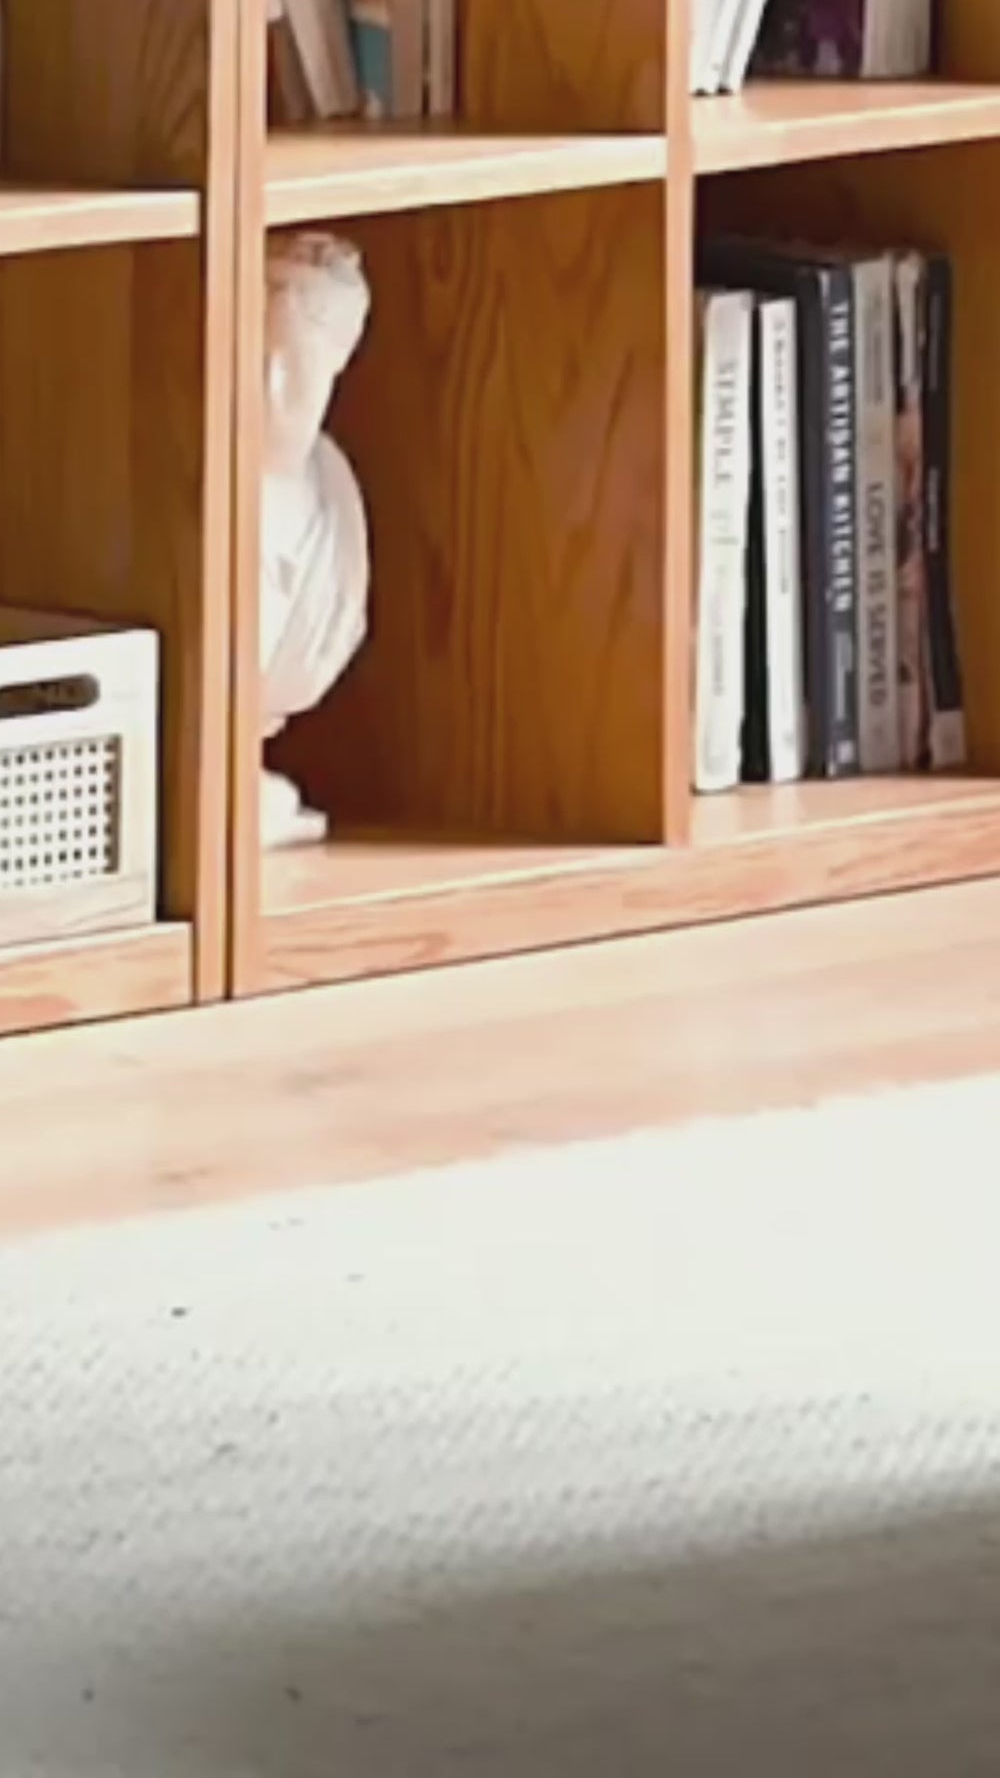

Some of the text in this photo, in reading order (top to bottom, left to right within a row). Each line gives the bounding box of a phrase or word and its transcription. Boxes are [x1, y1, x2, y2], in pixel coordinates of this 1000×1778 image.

[829, 301, 850, 353] THE
[713, 358, 738, 488] SIMPLE
[828, 365, 851, 484] ARTISAN
[829, 494, 853, 612] KITCHEN
[866, 481, 890, 708] LOVE IS SERVED
